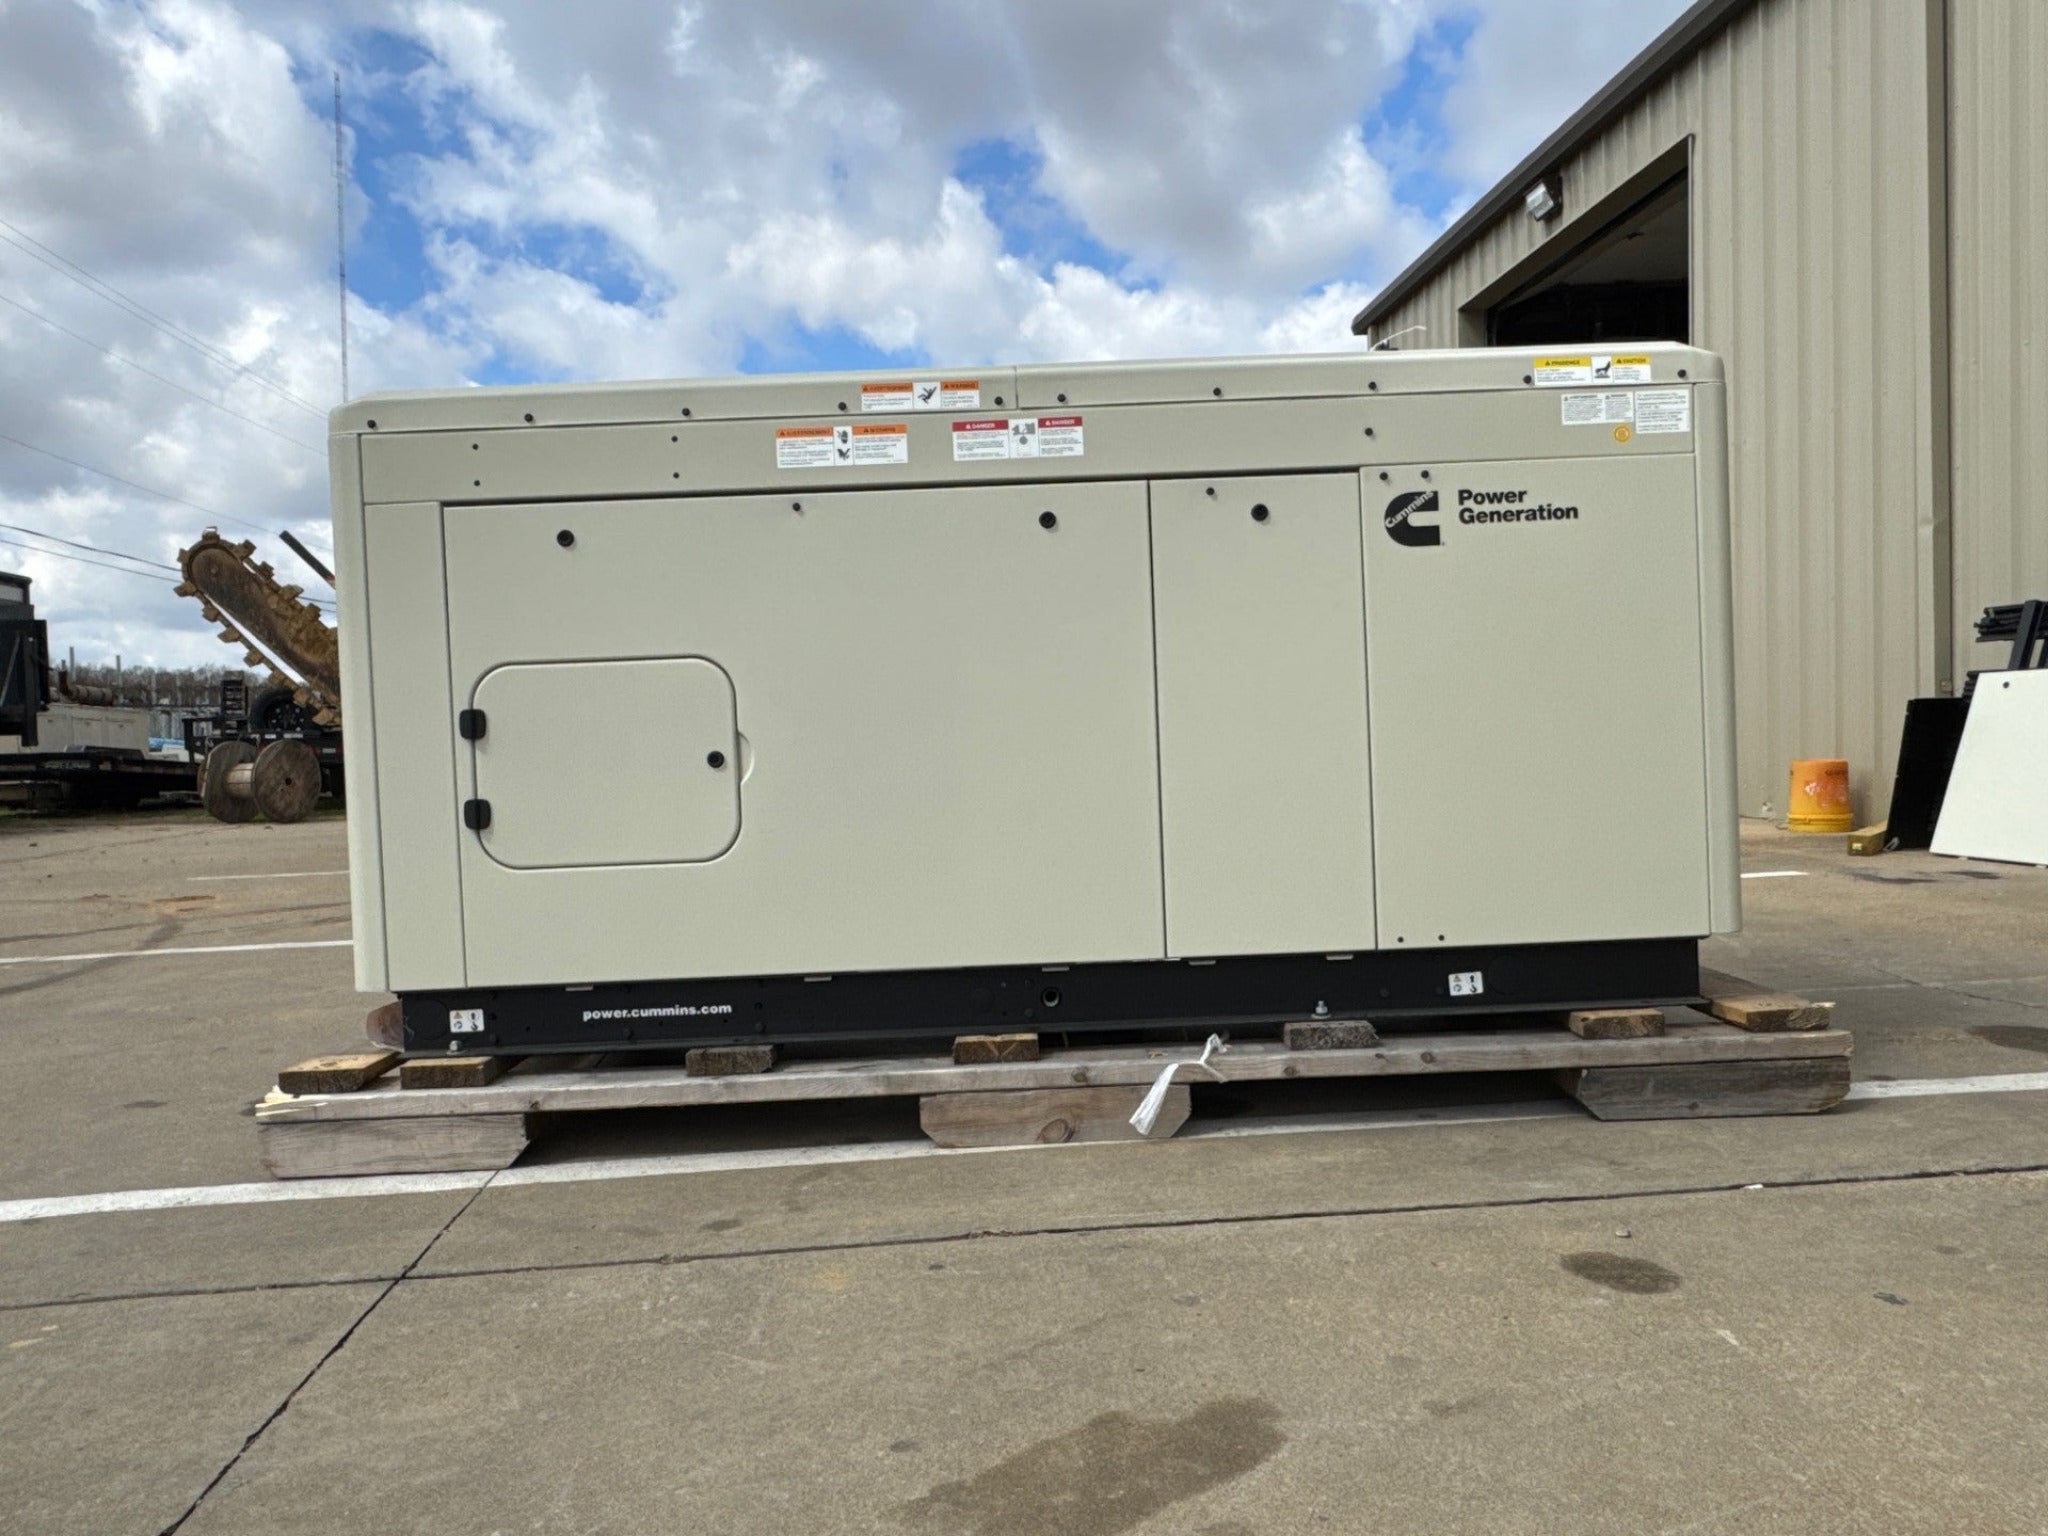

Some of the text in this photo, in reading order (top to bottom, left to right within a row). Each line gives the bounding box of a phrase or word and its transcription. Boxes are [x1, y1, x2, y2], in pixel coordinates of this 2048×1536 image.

[1458, 488, 1527, 505] Power
[1384, 490, 1434, 529] Cummins
[1458, 503, 1579, 525] Generation
[582, 1004, 733, 1022] power.cummins.com
